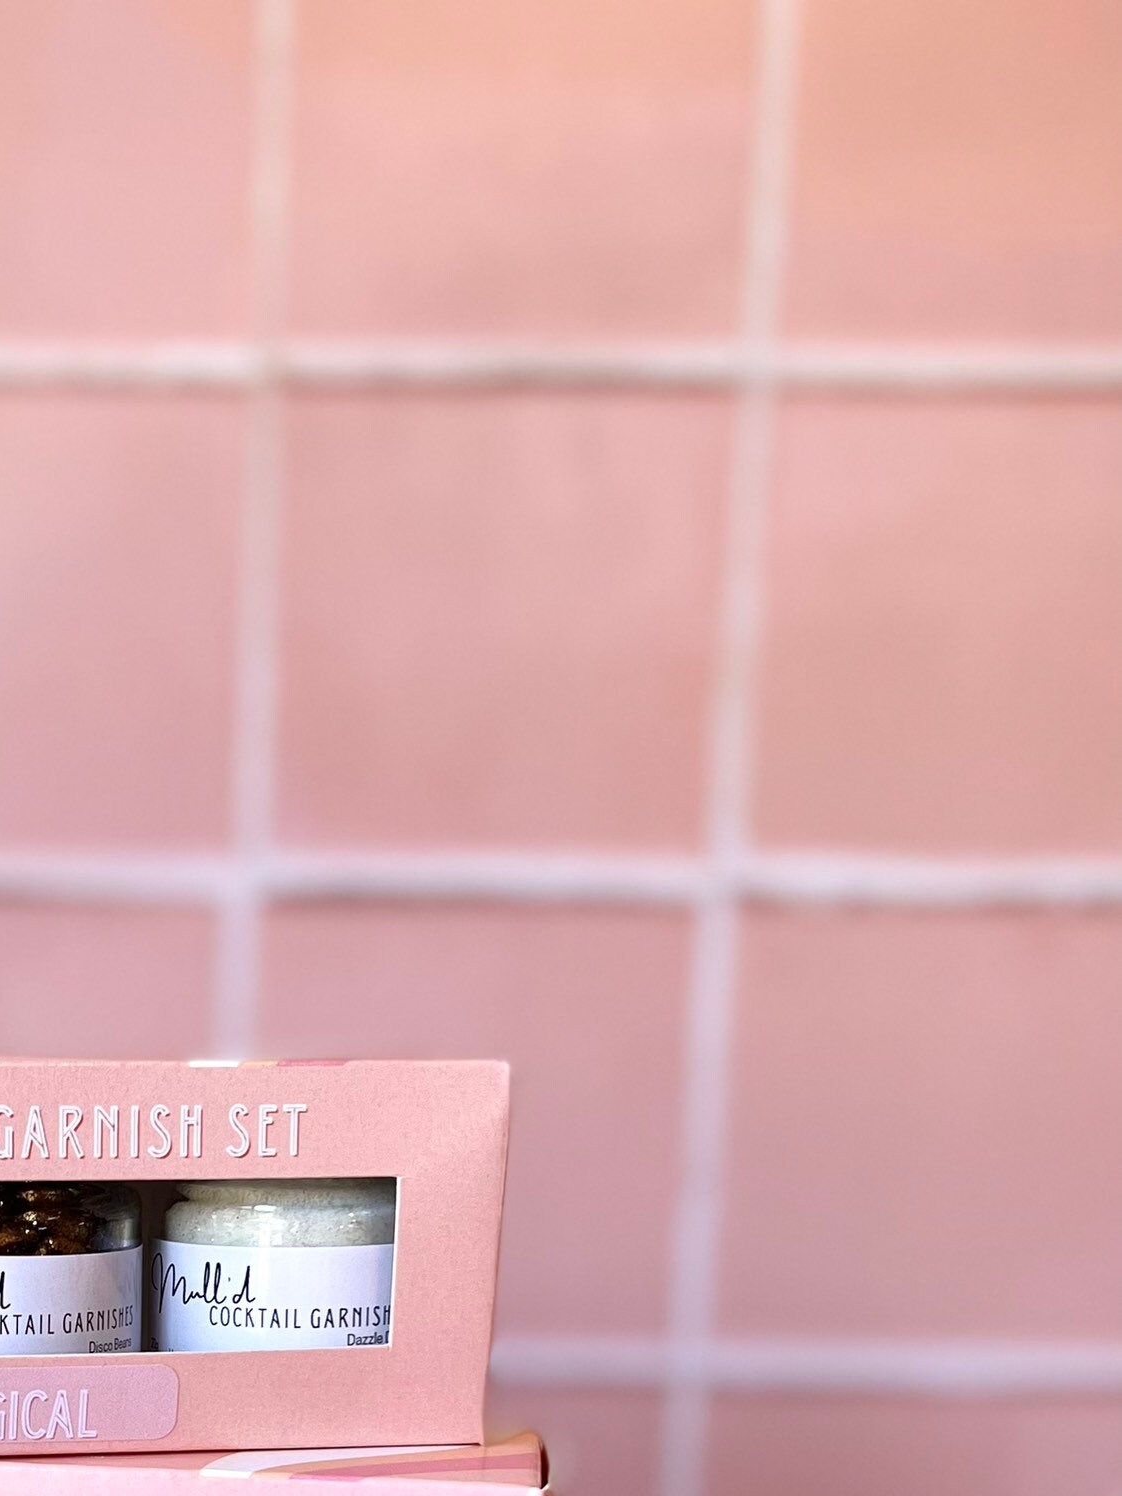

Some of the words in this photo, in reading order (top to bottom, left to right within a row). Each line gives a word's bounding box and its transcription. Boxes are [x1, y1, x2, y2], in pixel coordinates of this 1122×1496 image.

[225, 1104, 308, 1157] SET
[151, 1252, 256, 1313] Mull'd
[62, 1305, 134, 1335] GARNISHES
[209, 1305, 302, 1328] COCKTAIL
[88, 1339, 113, 1354] Disco
[114, 1336, 132, 1350] Beans
[346, 1332, 384, 1346] Dazzle
